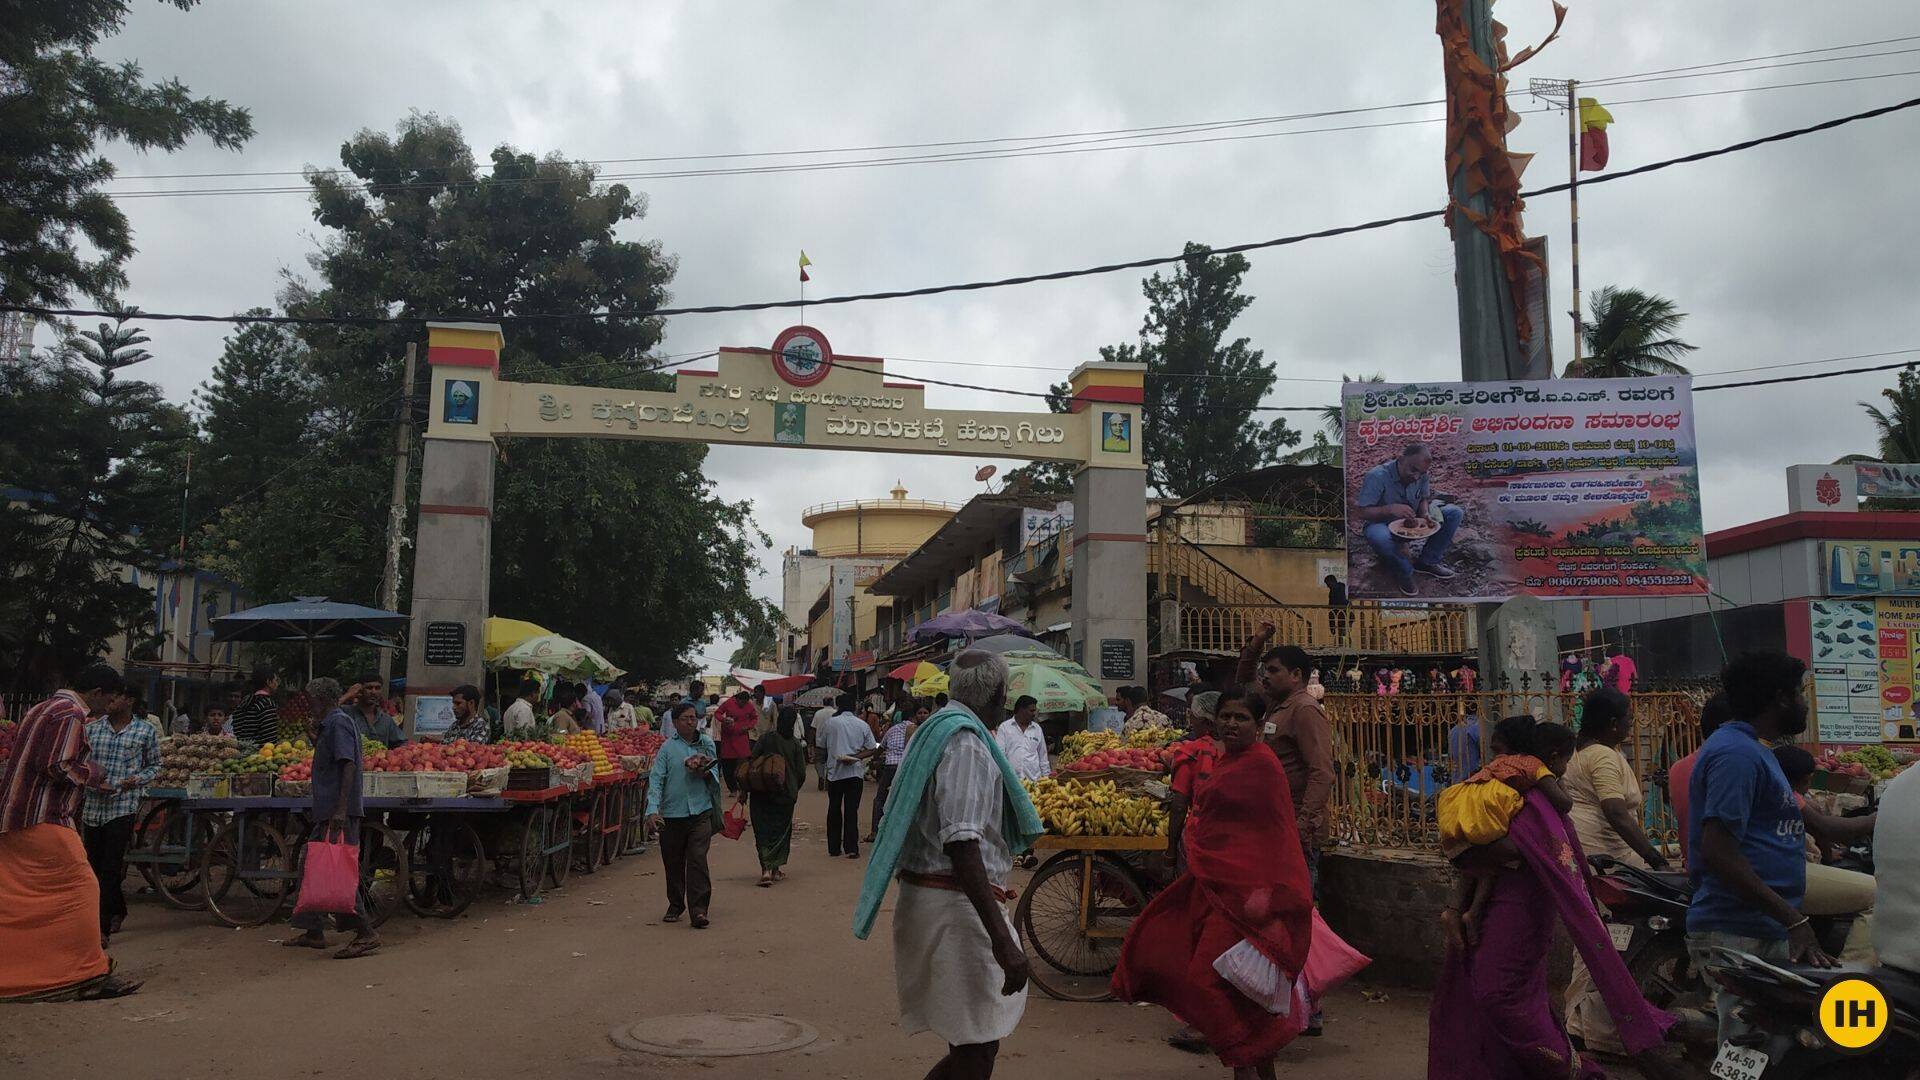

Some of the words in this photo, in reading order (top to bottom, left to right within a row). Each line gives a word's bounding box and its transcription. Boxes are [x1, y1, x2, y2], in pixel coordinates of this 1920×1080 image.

[699, 383, 743, 400] ನಗರ
[750, 385, 780, 405] ಸಭೆ
[1617, 386, 1675, 402] ರವರಿಗೆ
[539, 393, 573, 421] ಶ್ರೀ
[826, 415, 949, 446] ಮಾರುಕಟ್ಟೆ
[957, 419, 1065, 448] ಹೆಬ್ಬಾಗಿಲು
[1472, 413, 1575, 433] ಅಭಿನಂದನಾ
[1584, 410, 1682, 431] ಸಮಾರಂಭ
[1878, 611, 1904, 620] HOME
[1725, 1050, 1756, 1070] KA-50
